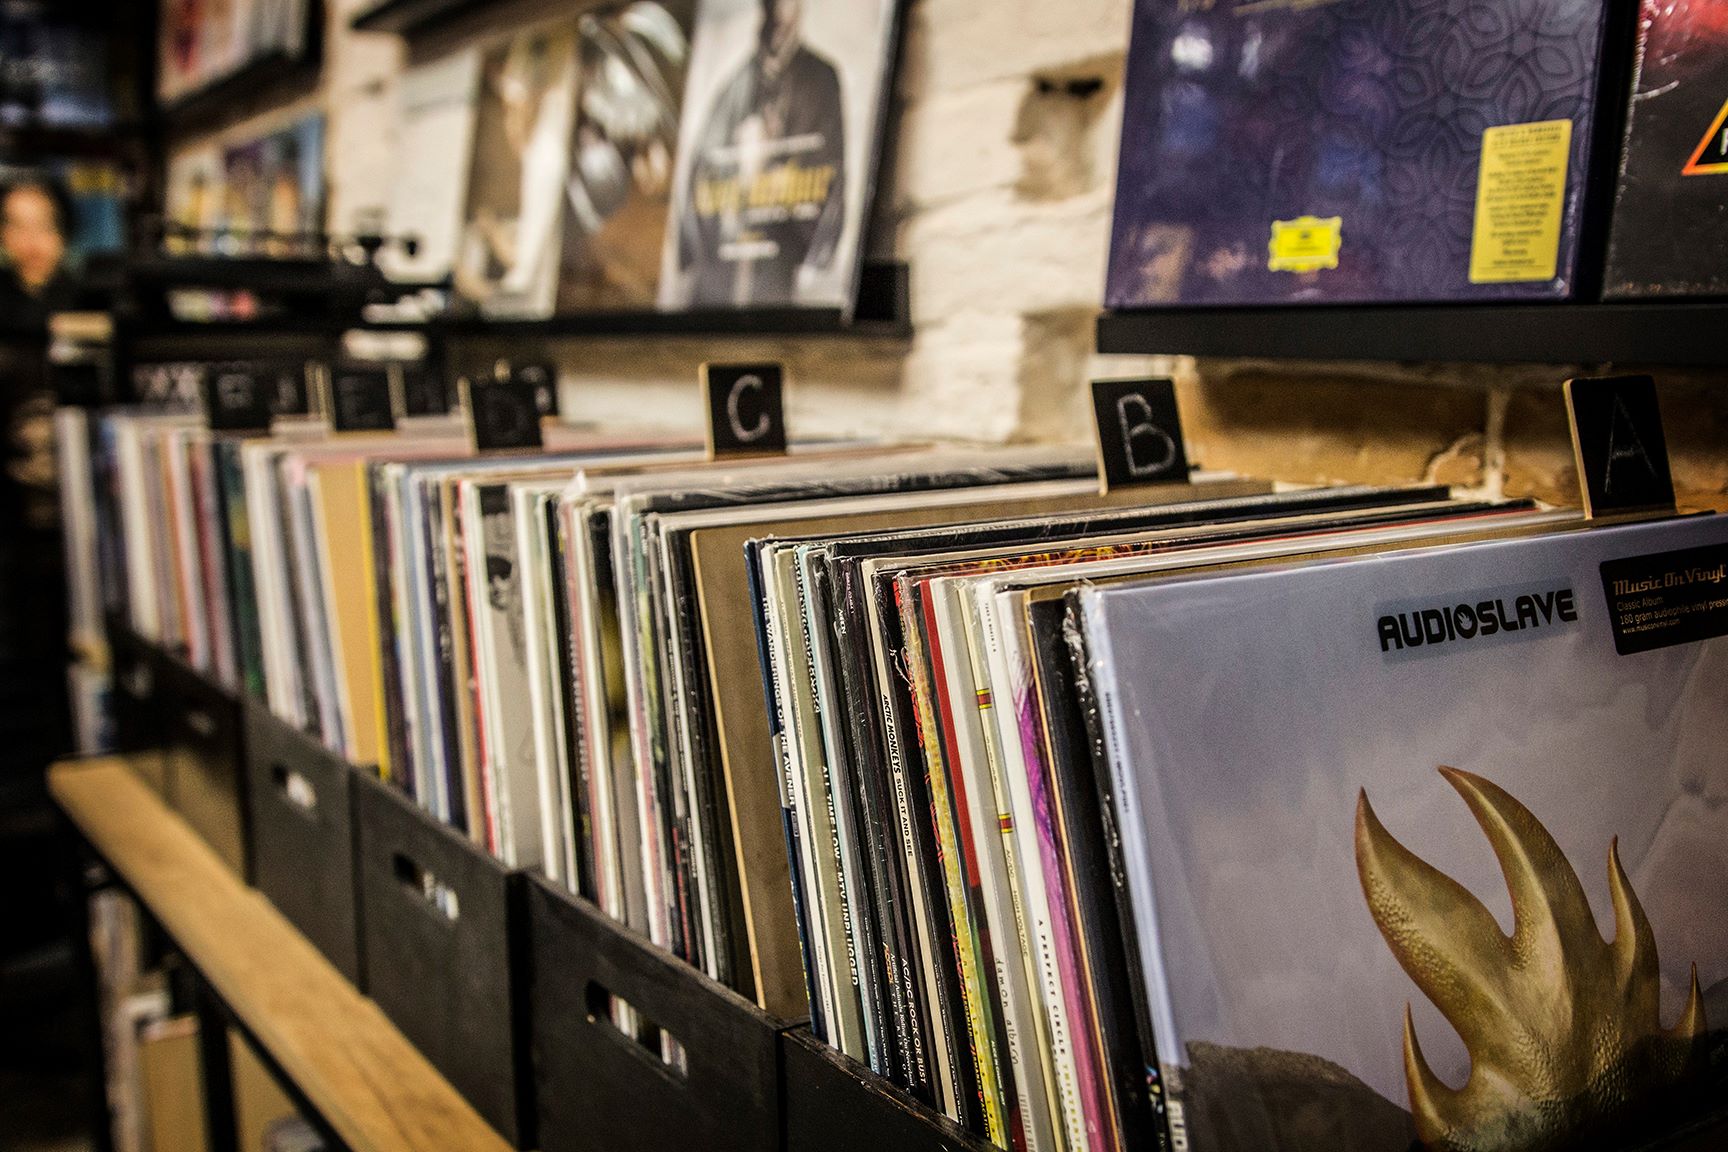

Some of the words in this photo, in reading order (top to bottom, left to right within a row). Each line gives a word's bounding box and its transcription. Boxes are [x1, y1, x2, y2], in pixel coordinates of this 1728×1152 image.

[727, 374, 770, 441] C
[1116, 393, 1176, 476] B
[1603, 393, 1658, 493] A
[1612, 575, 1663, 596] Music
[1664, 571, 1686, 588] On
[1684, 563, 1727, 583] Vinyl
[1378, 589, 1578, 651] AUDIOSLAVE
[763, 595, 771, 622] THE
[767, 622, 782, 705] WANDERINGS
[778, 705, 784, 724] OF
[784, 753, 795, 806] AVENER
[882, 693, 893, 725] ARCTIC
[886, 723, 901, 774] MONKEYS
[895, 777, 905, 805] SUCK
[899, 804, 906, 814] IT
[825, 793, 835, 825] TIME
[836, 870, 845, 899] MTV
[900, 815, 910, 837] AND
[904, 837, 912, 857] SEE
[1004, 848, 1014, 879] AC/DC
[1012, 889, 1020, 913] HIGH
[1016, 913, 1028, 958] VOLTAGE
[900, 957, 912, 999] AC/DC
[1037, 918, 1043, 927] A
[1040, 933, 1055, 997] PERFECT
[1052, 1003, 1065, 1056] CIRCLE
[908, 1000, 918, 1035] ROCK
[994, 956, 1011, 1008] damon
[1004, 1018, 1020, 1066] albarn
[913, 1036, 921, 1055] OR
[916, 1055, 926, 1084] BUST
